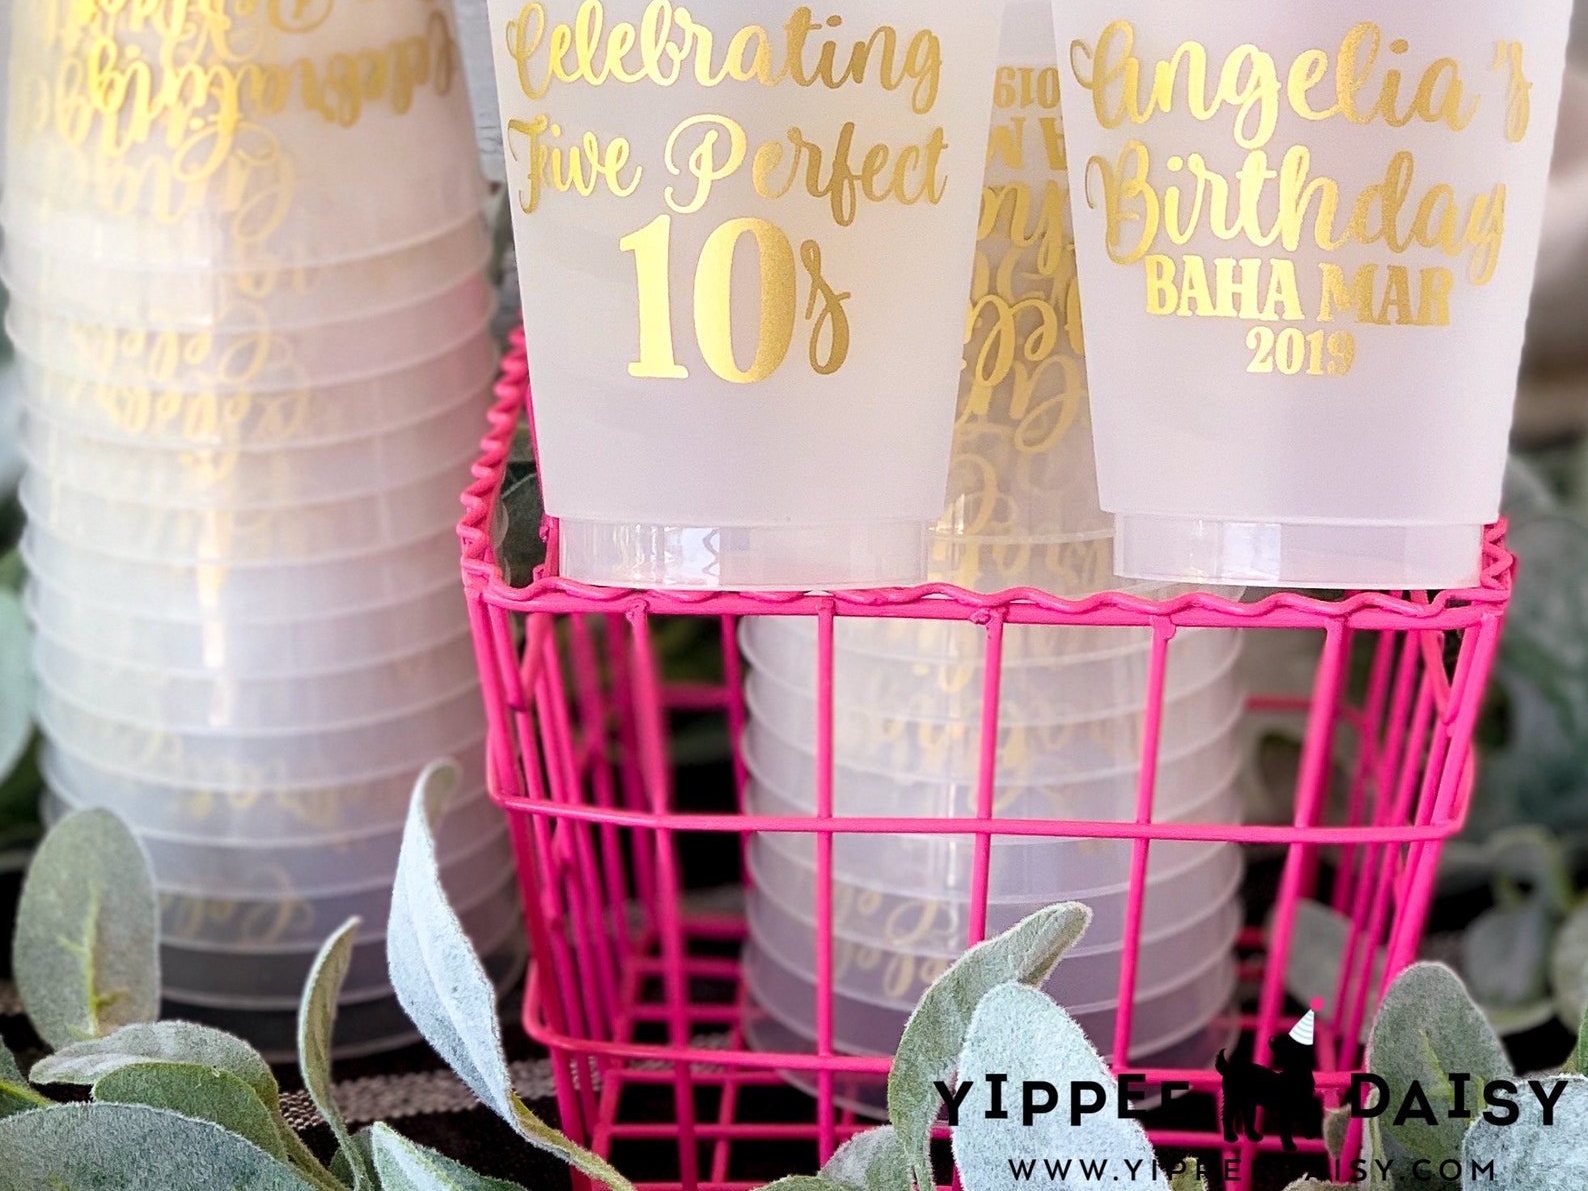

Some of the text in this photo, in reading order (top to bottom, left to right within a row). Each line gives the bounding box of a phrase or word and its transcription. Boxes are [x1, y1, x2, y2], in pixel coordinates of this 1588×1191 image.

[993, 66, 1060, 109] 019
[1070, 20, 1533, 149] Angelia's
[508, 114, 642, 215] Five
[664, 113, 948, 227] Perfect
[1085, 141, 1506, 286] Birthday
[619, 214, 852, 384] 10s
[1145, 255, 1455, 326] BAHA MAR
[1246, 327, 1356, 377] 2019
